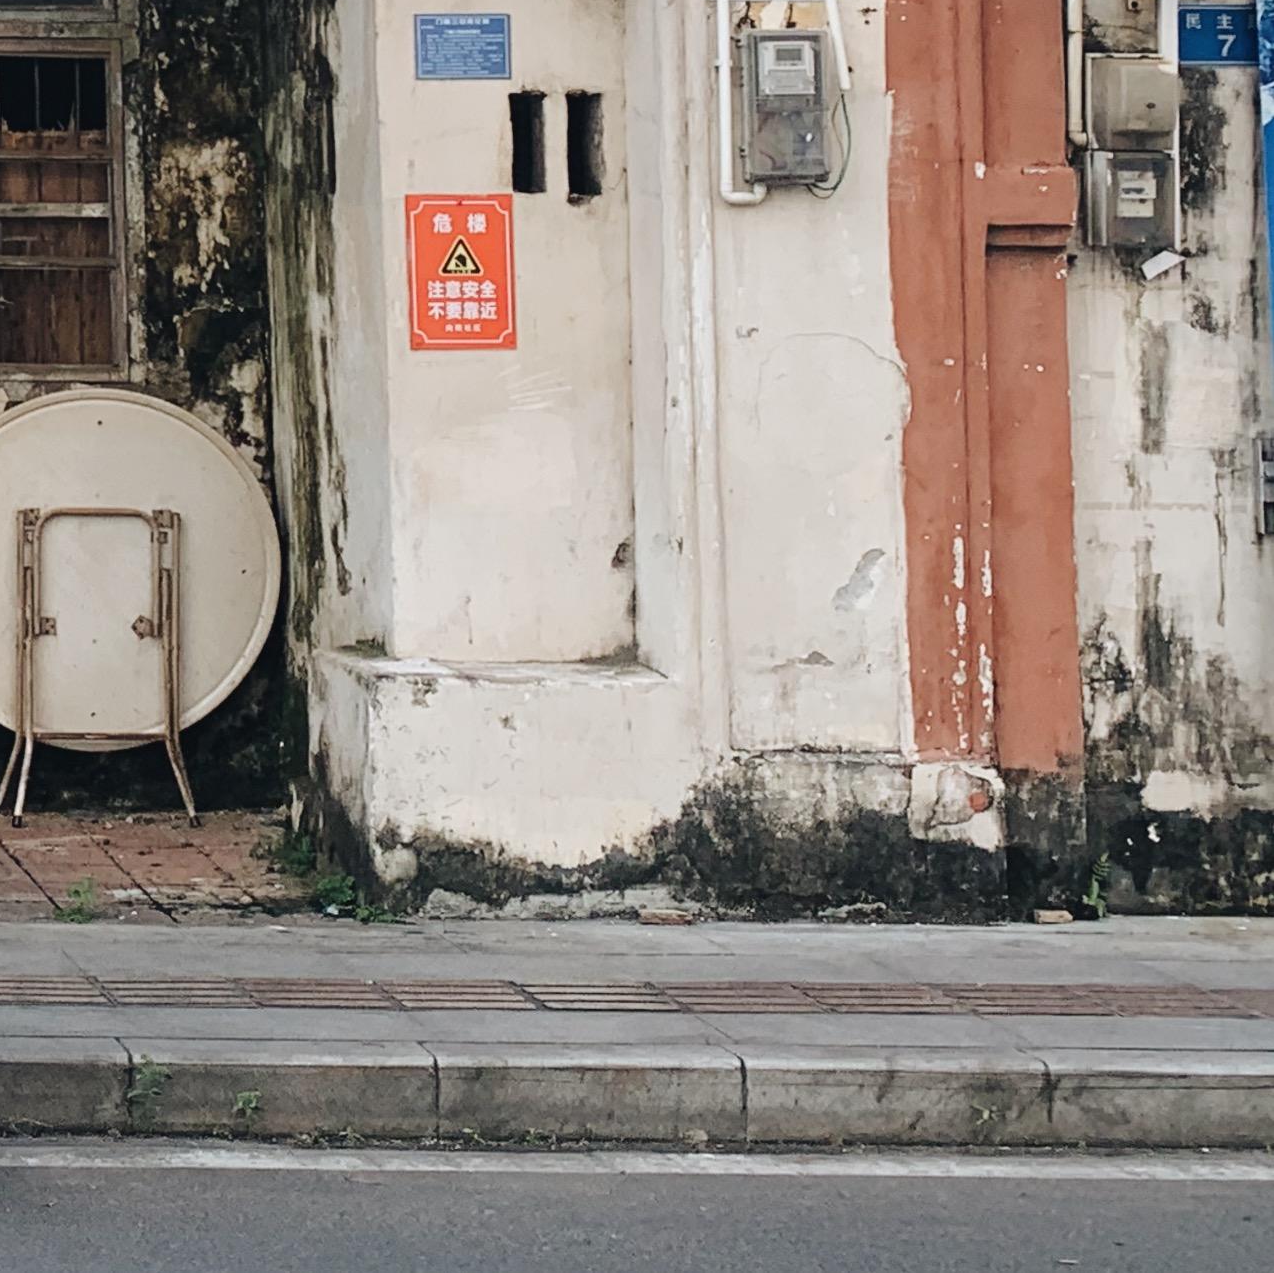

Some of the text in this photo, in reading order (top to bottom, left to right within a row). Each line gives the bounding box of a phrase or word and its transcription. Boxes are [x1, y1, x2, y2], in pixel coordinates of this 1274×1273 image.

[1185, 13, 1254, 30] 民主
[1217, 34, 1237, 57] 7
[432, 212, 487, 234] 危楼
[427, 280, 497, 299] 注意安全
[427, 301, 498, 320] 不要靠近
